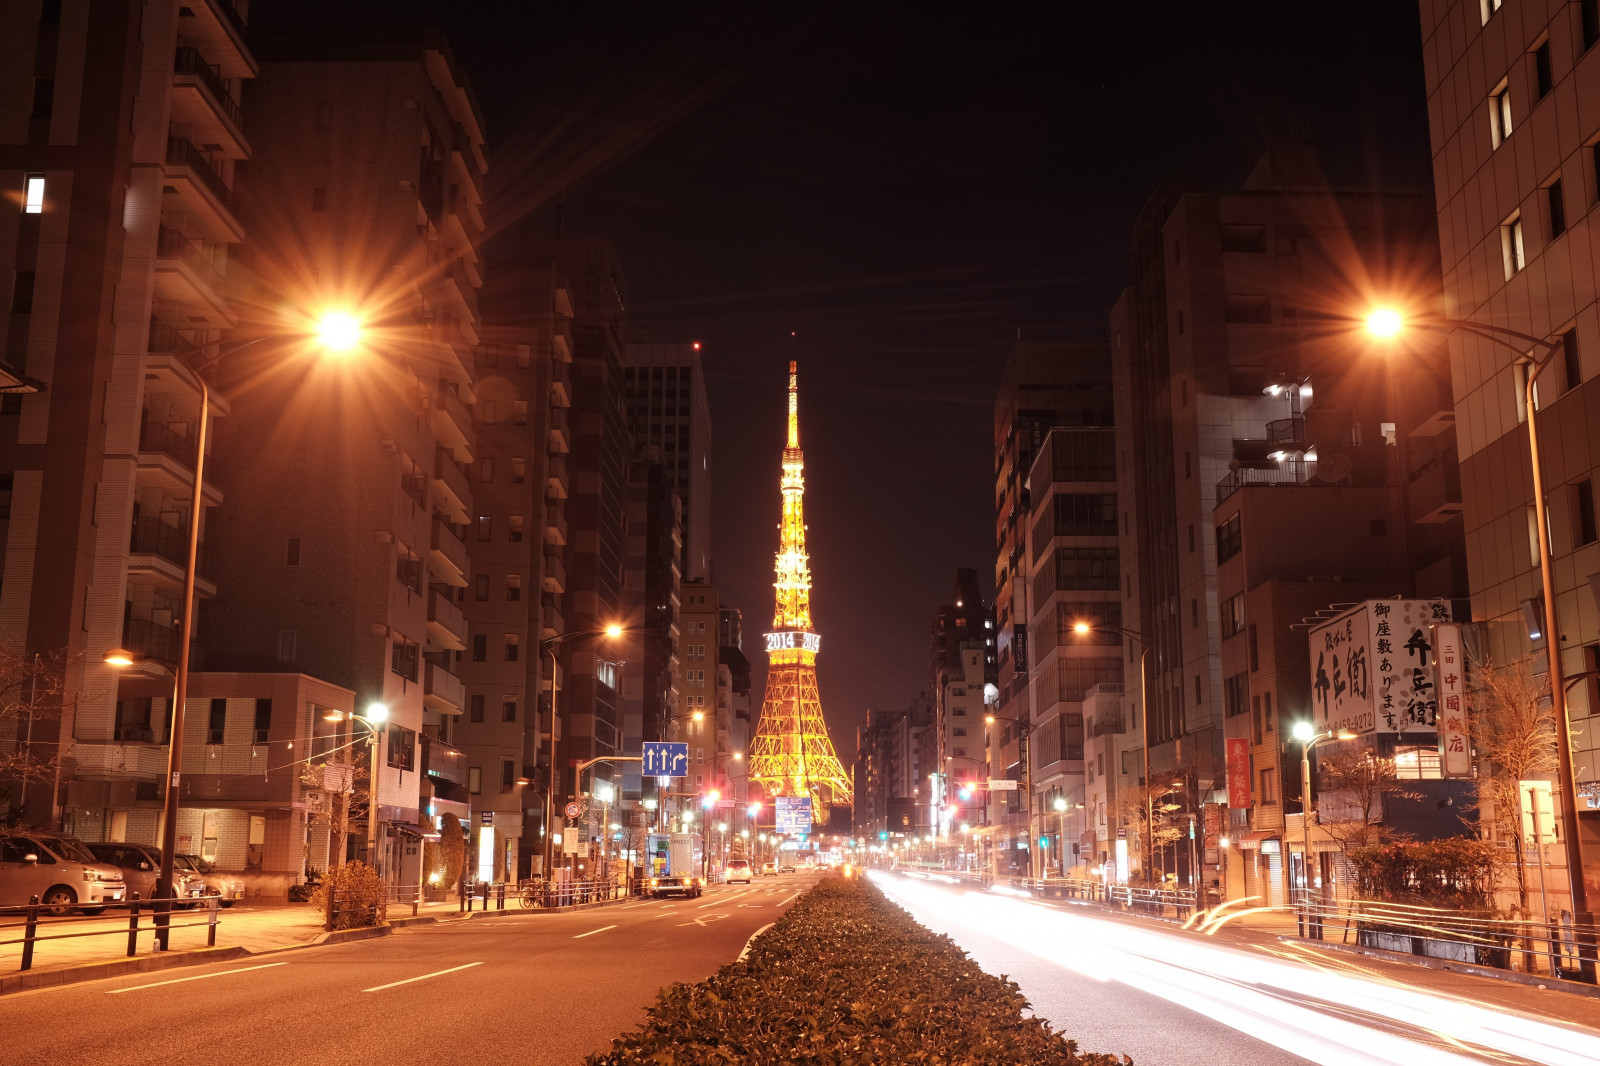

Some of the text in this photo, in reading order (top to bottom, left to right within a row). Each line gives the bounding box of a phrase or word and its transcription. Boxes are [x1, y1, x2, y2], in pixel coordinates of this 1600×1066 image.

[767, 633, 795, 650] 2014
[802, 633, 820, 651] 2014
[1444, 645, 1455, 664] 三田
[1374, 602, 1398, 731] 御座敷あります。
